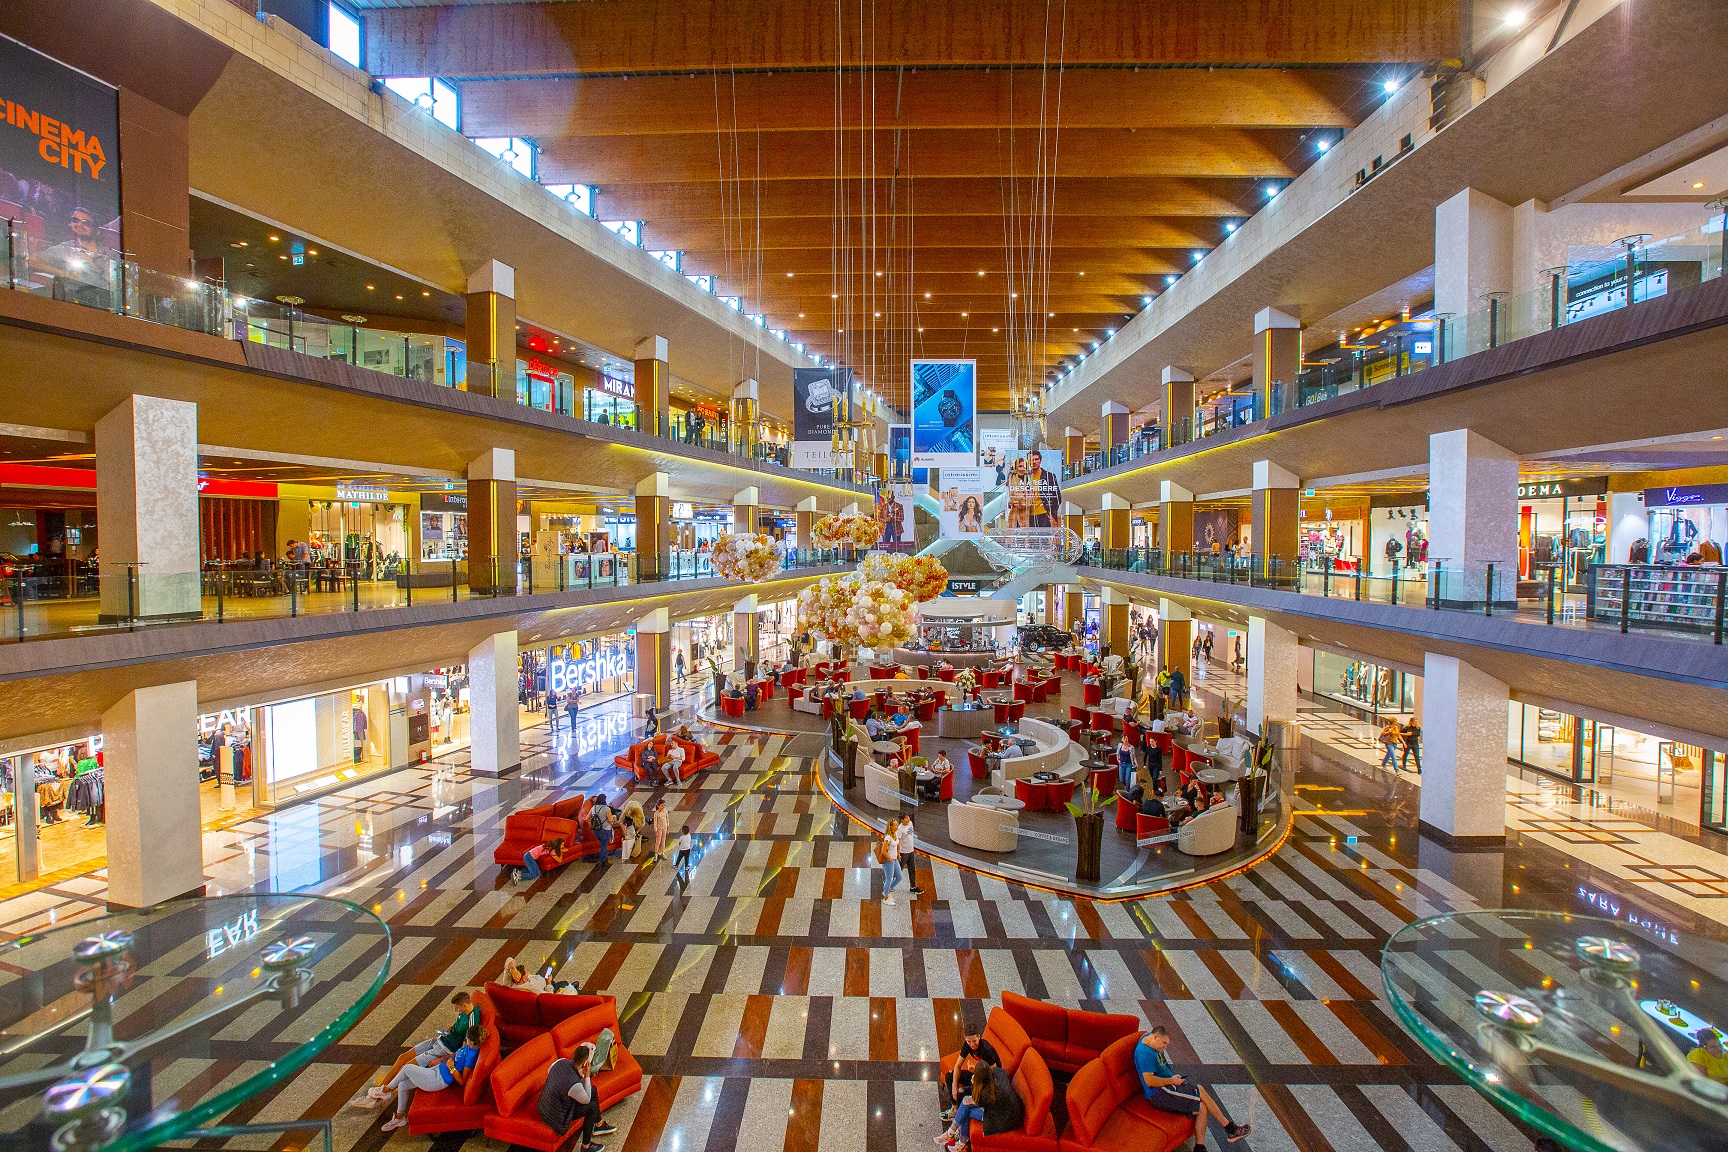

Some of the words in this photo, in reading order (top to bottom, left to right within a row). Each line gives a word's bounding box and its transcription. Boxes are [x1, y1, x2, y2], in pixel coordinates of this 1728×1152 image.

[39, 138, 106, 179] CITY
[805, 451, 843, 459] TEILO
[336, 490, 389, 501] MATHILDE
[448, 494, 468, 504] Intero
[951, 582, 976, 590] iSTYLE
[551, 650, 627, 693] Bershka
